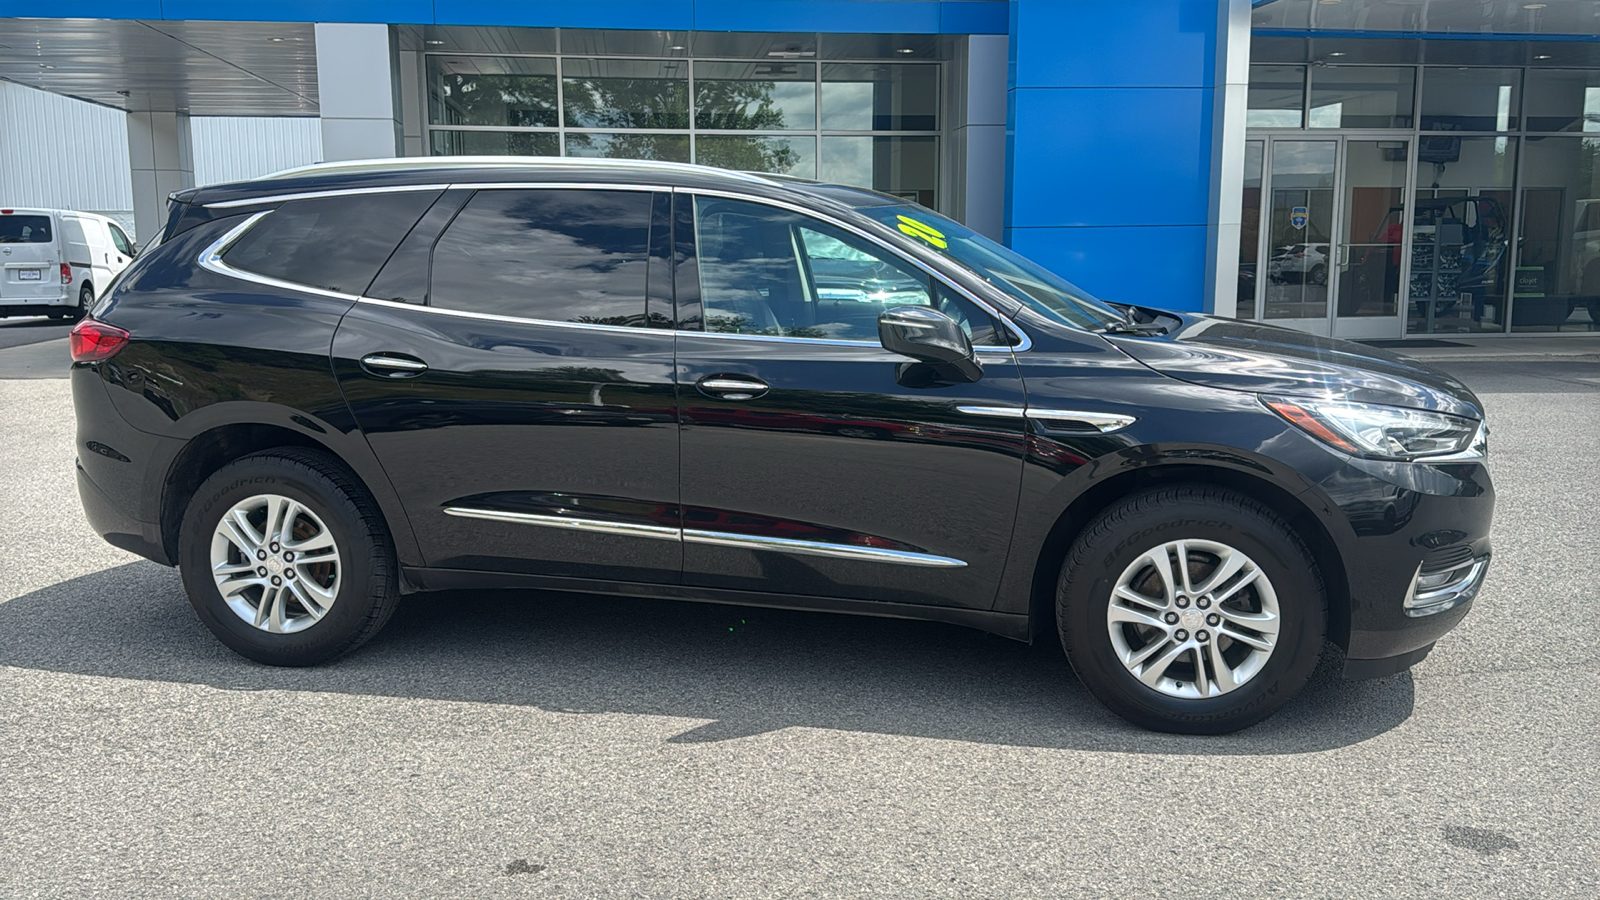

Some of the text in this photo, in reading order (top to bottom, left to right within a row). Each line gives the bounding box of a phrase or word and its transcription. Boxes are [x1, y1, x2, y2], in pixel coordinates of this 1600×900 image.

[896, 214, 948, 249] 20
[1103, 518, 1234, 570] BFGoodrich
[1163, 679, 1280, 722] Advantage
